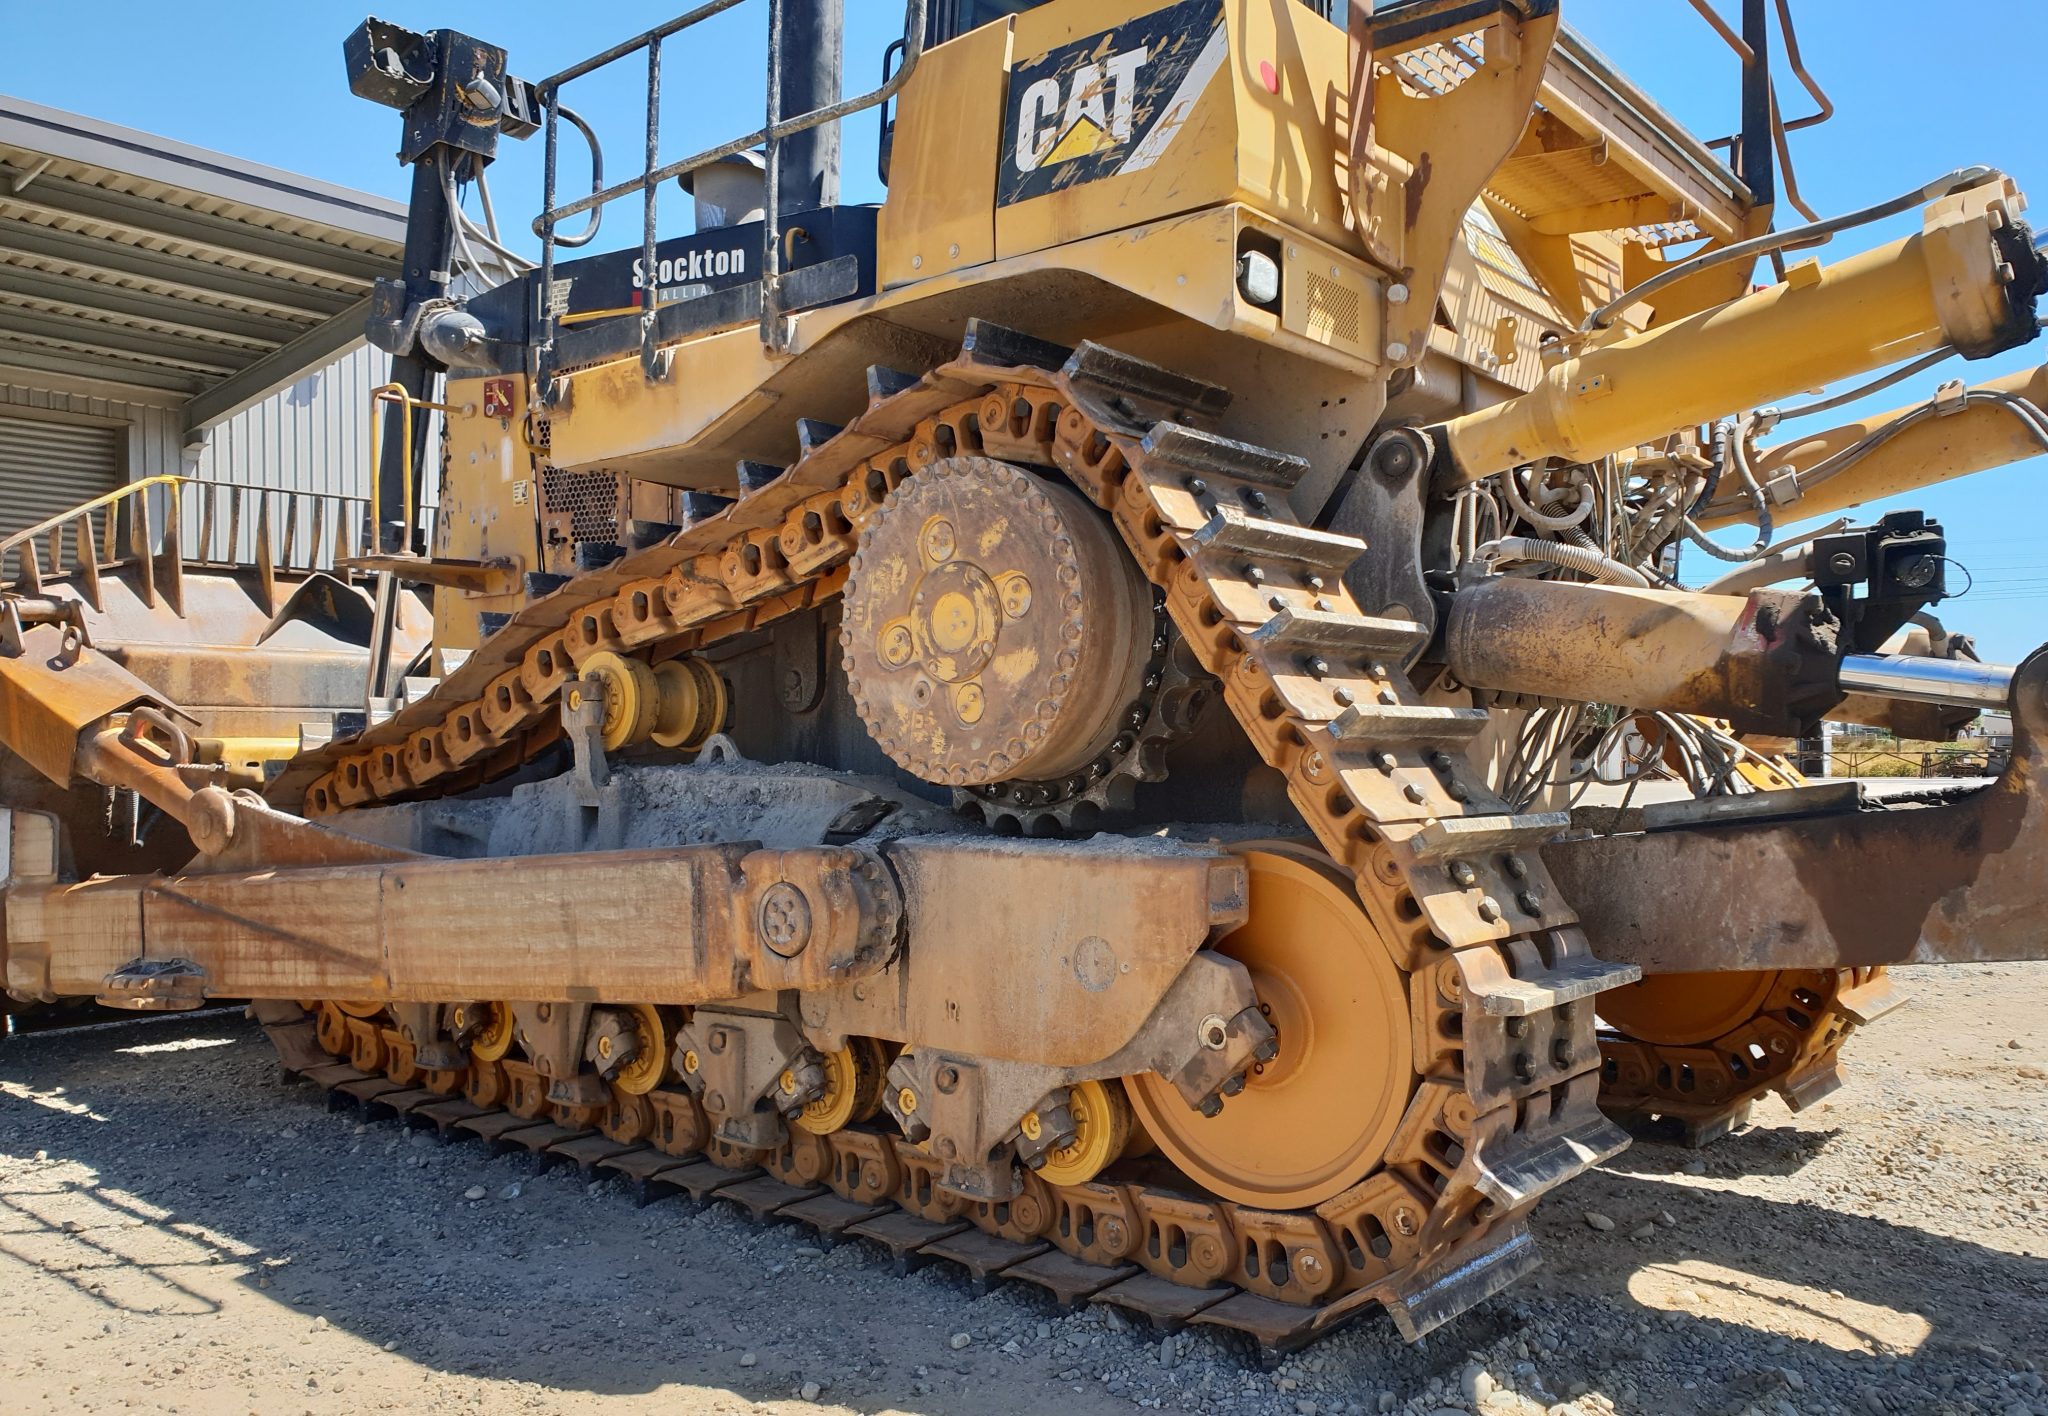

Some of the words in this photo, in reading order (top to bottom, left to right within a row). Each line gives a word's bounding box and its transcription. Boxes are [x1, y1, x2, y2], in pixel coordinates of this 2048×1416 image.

[1015, 46, 1148, 173] CAT
[632, 248, 745, 288] Sockton
[662, 284, 712, 301] ALLIA
